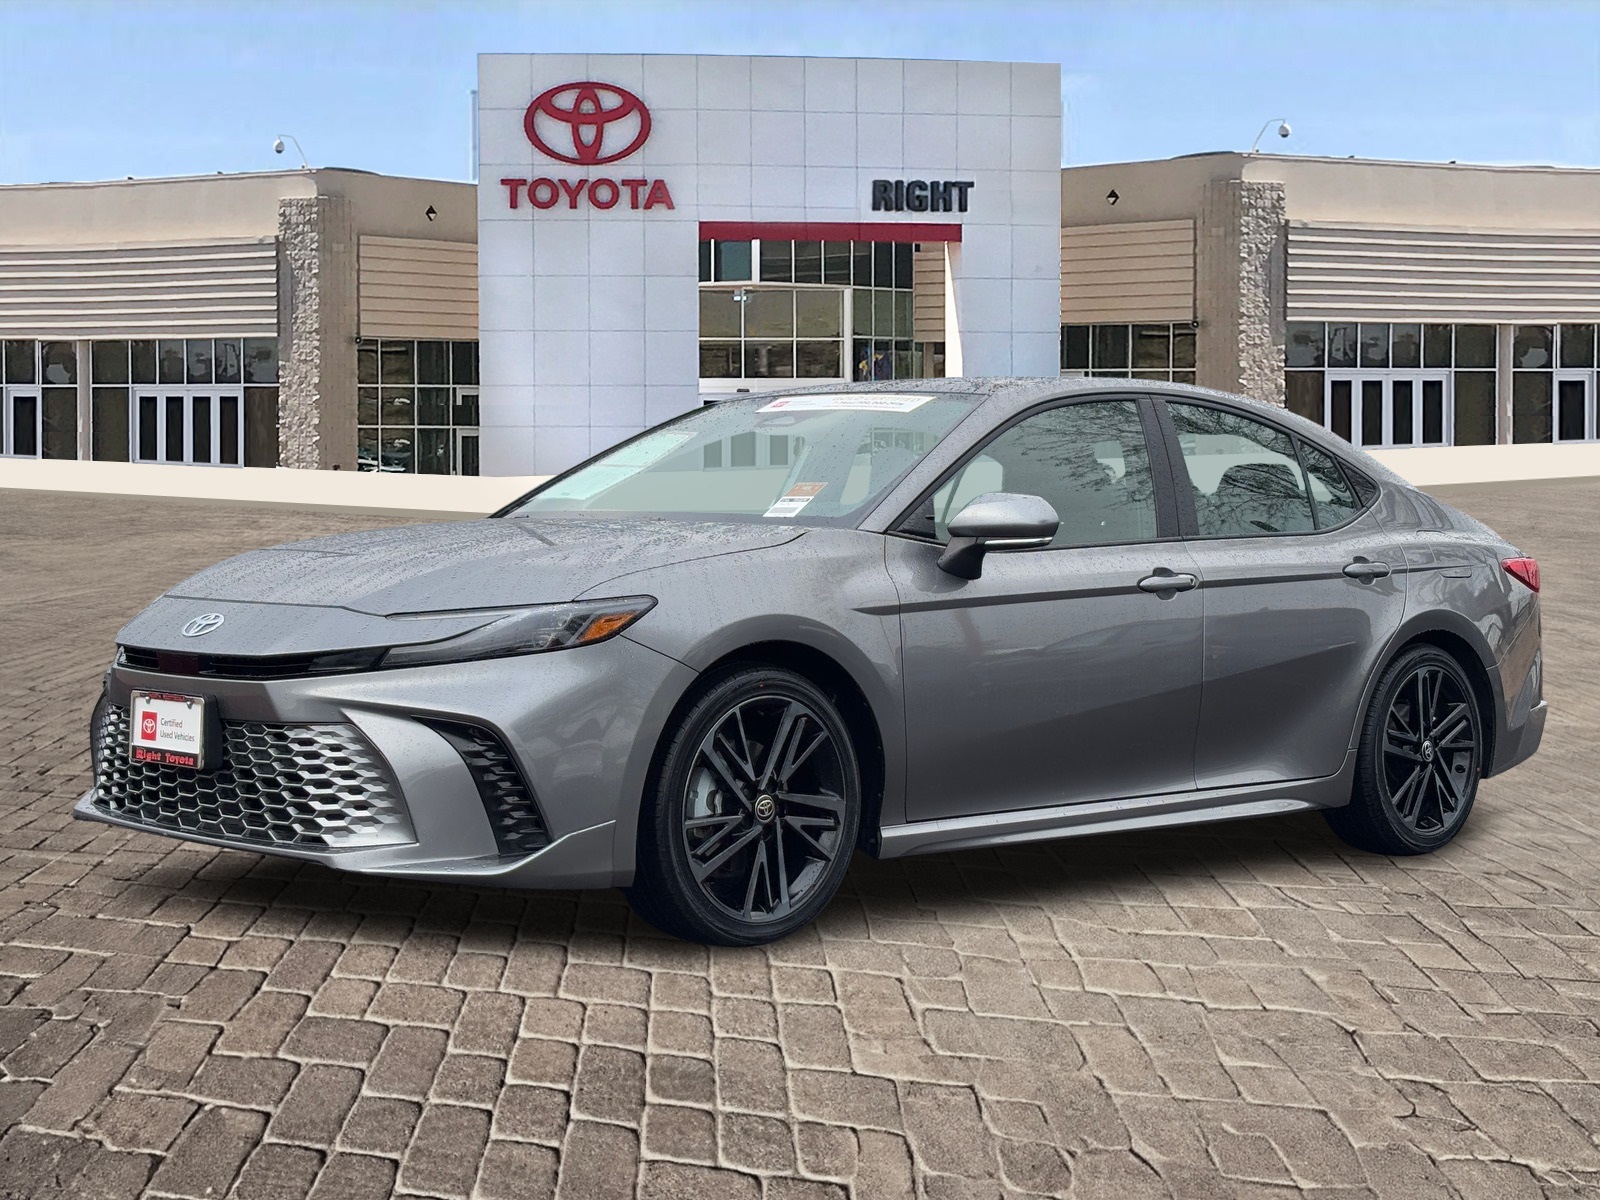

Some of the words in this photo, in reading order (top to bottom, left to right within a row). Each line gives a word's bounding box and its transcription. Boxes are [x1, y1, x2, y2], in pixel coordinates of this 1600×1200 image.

[500, 178, 675, 210] TOYOTA
[872, 179, 975, 212] RIGHT
[160, 717, 183, 728] Certified
[160, 730, 173, 739] Used
[174, 731, 195, 741] Vehicles
[135, 748, 161, 761] Right
[165, 752, 194, 765] Toyota
